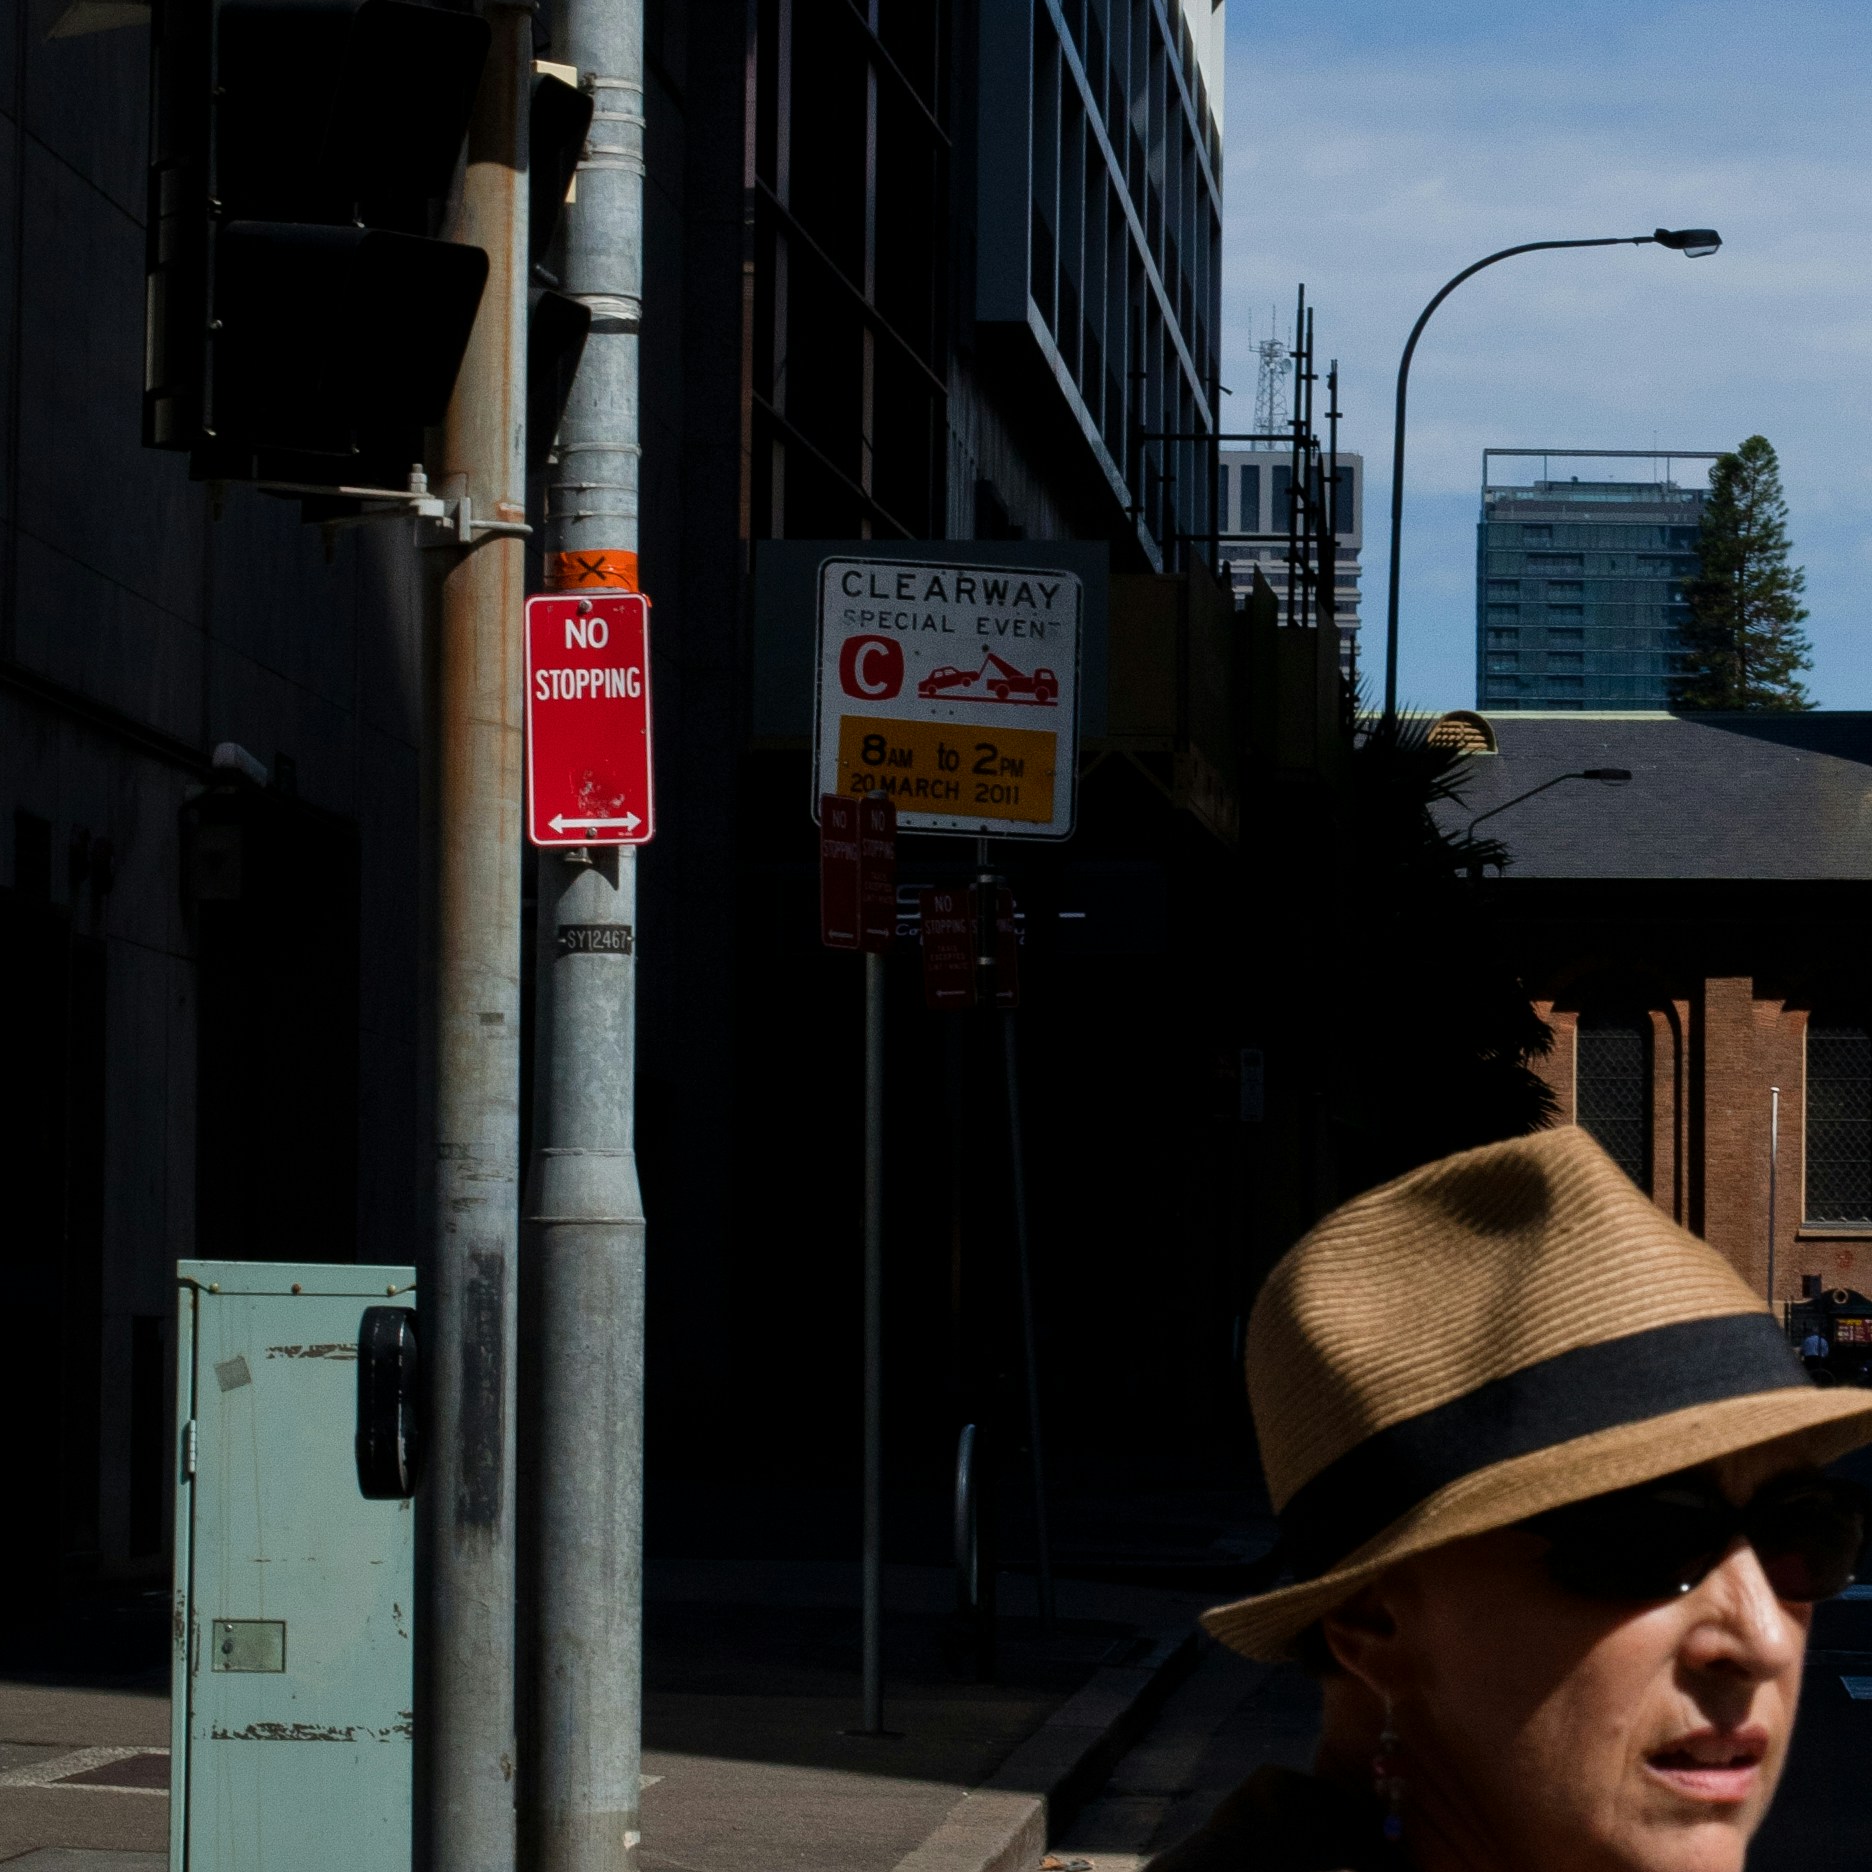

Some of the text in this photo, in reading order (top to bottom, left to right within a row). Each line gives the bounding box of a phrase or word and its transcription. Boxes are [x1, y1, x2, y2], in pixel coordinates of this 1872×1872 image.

[841, 570, 1061, 609] CLEARWAY
[565, 617, 609, 649] NO
[842, 609, 956, 634] SPECIAL
[854, 640, 890, 696] C
[536, 666, 641, 701] STOPPING
[861, 733, 1024, 779] 8AM to 2PM
[851, 772, 1019, 806] 20 MARCH 2011
[832, 809, 848, 829] NO
[870, 809, 886, 832] NO
[934, 895, 953, 913] NO
[567, 930, 627, 951] SY12467
[924, 918, 968, 935] STOPPING
